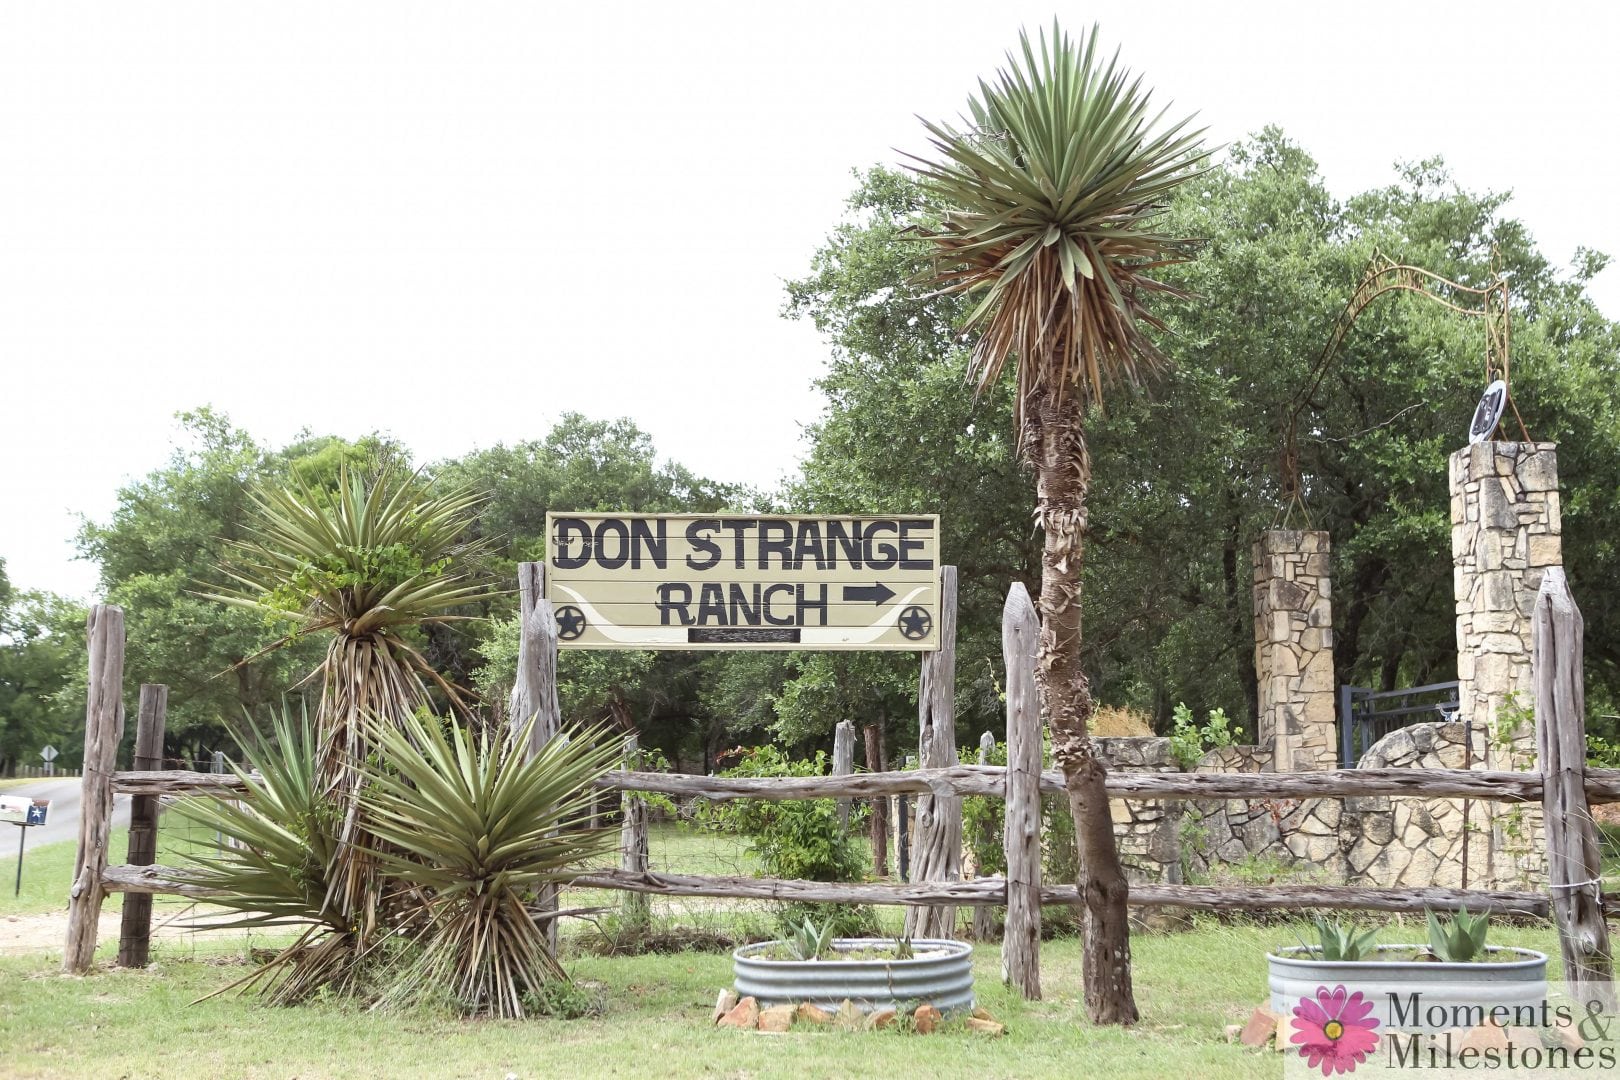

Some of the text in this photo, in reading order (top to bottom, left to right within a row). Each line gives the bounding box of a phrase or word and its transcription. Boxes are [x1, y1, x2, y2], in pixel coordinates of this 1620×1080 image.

[552, 518, 934, 570] DON STRANGE
[655, 583, 828, 626] RANCH
